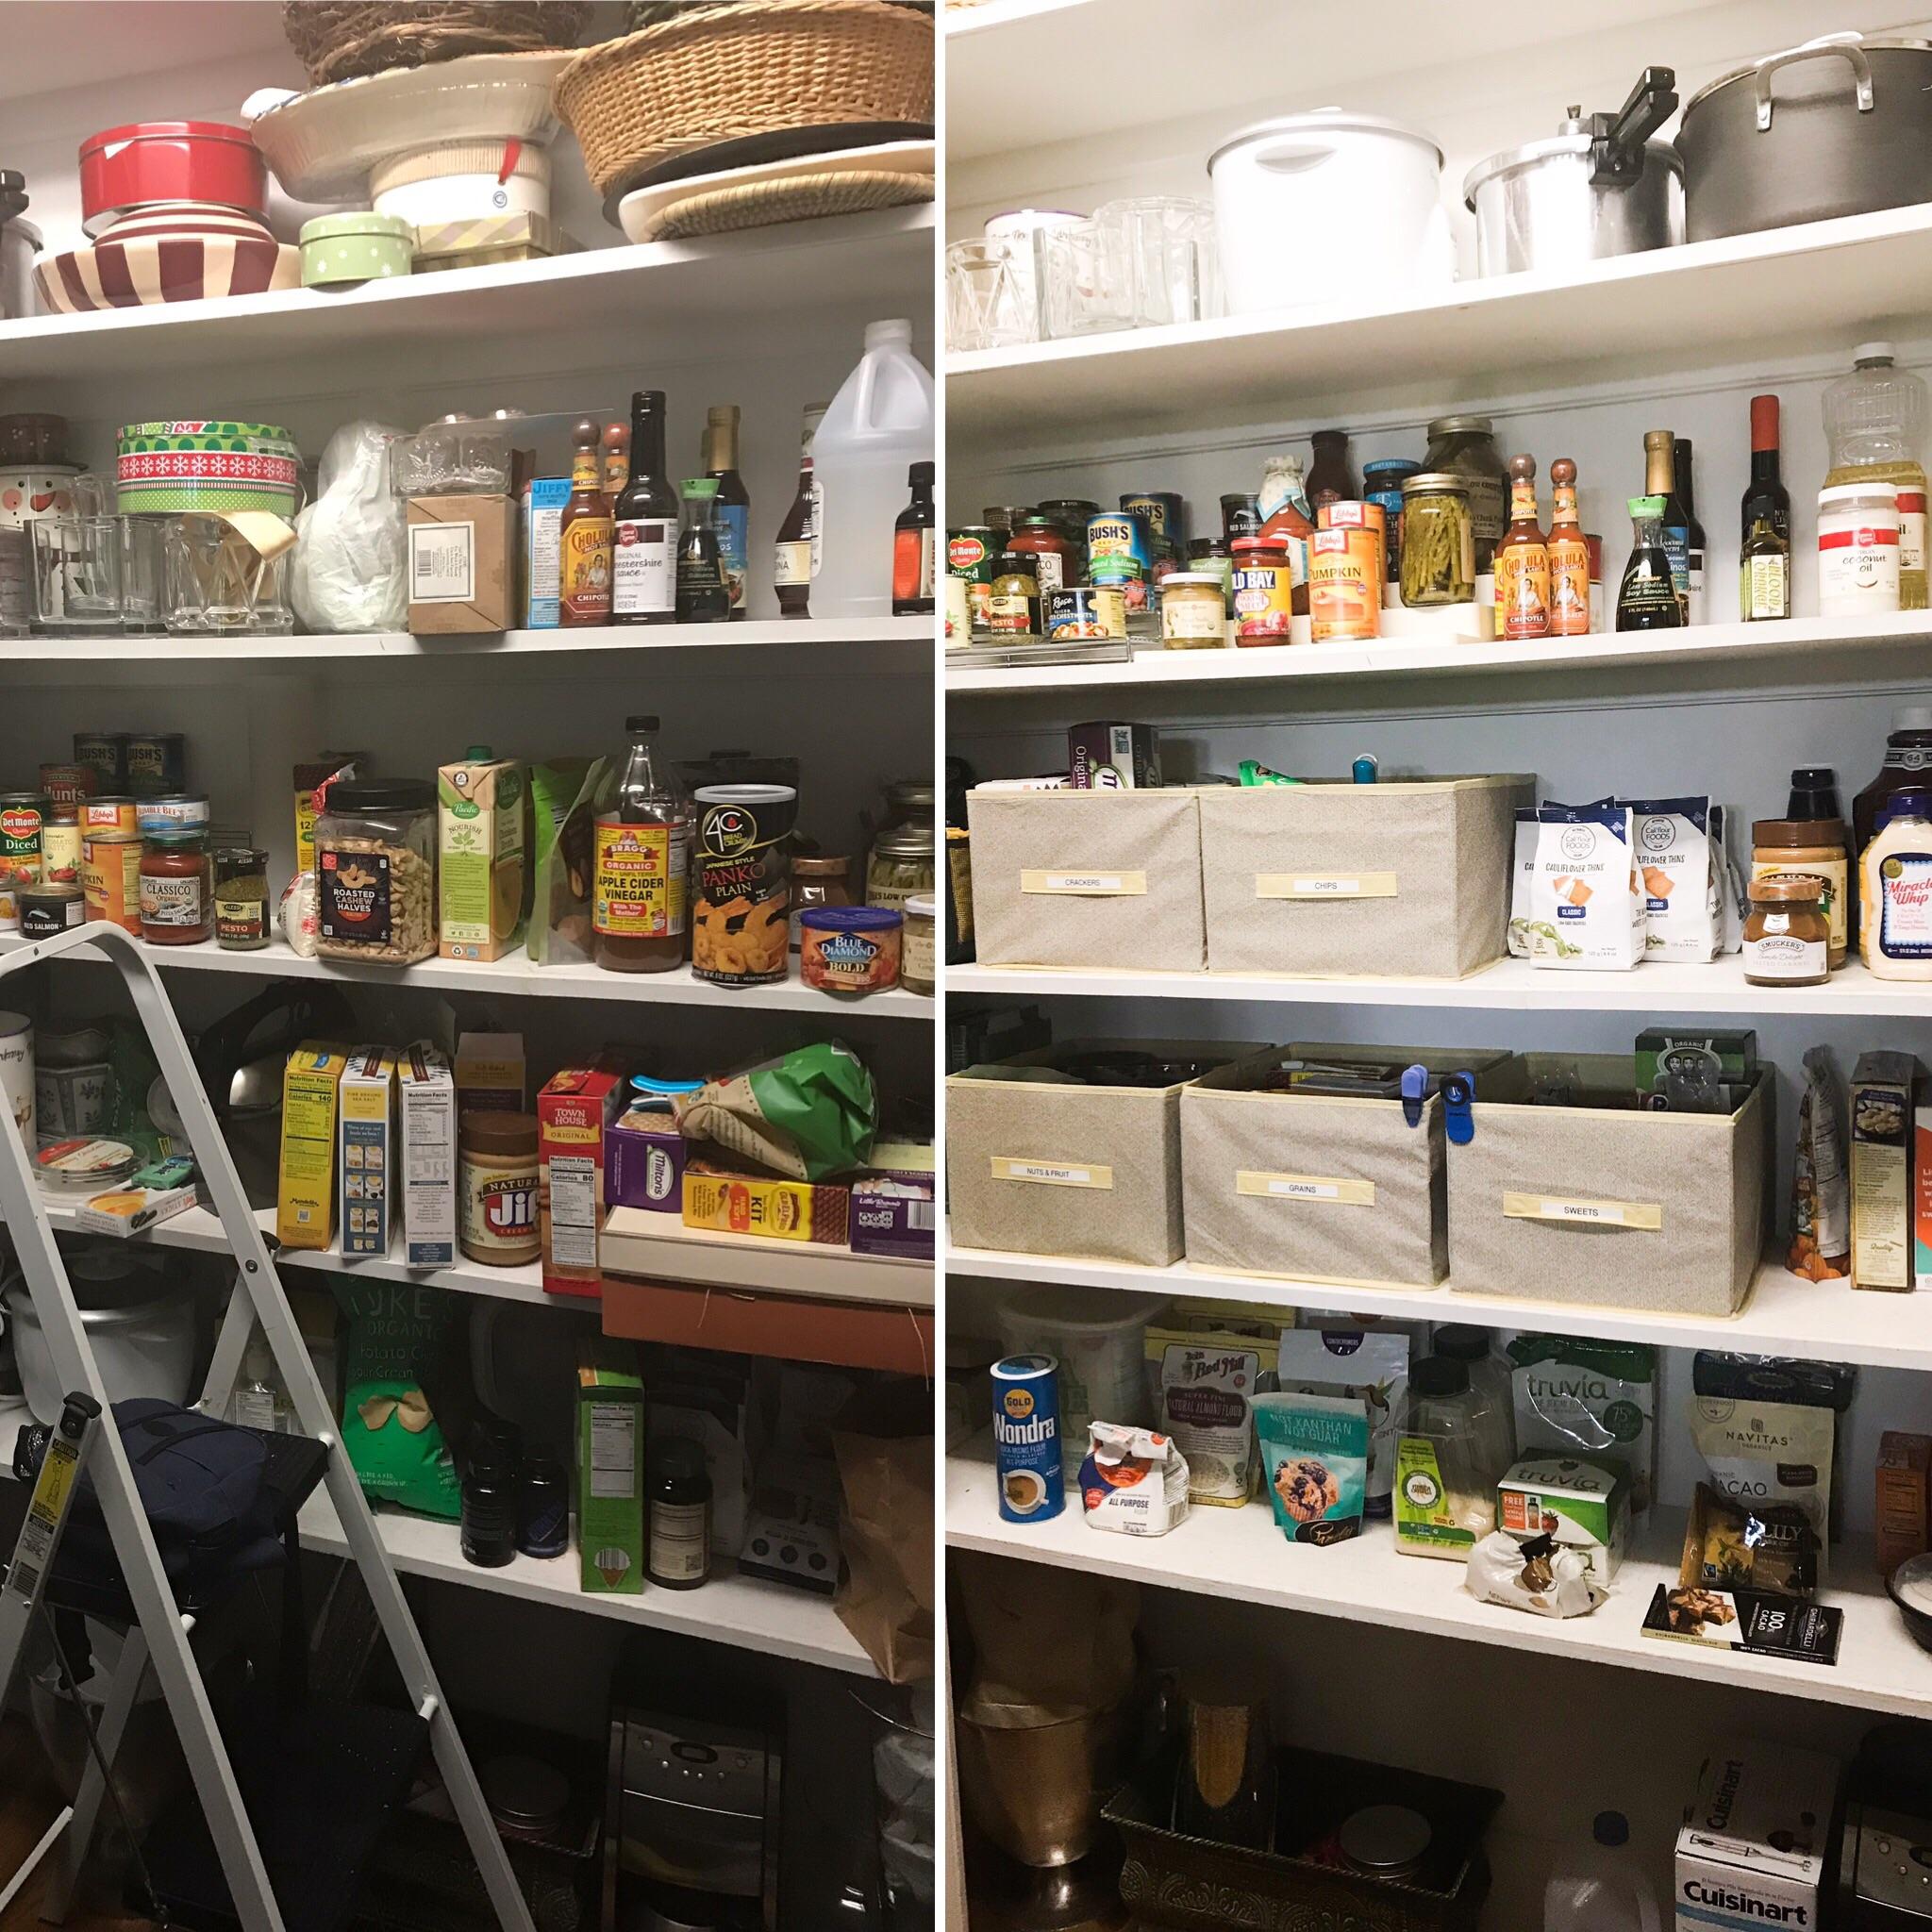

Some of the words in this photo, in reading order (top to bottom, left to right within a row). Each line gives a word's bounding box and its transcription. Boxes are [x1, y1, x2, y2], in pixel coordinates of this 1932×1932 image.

[1090, 525, 1129, 542] BUSH'S
[1842, 555, 1888, 564] coconut
[1309, 566, 1361, 579] PUMPKIN
[1670, 562, 1687, 571] inos
[1859, 564, 1873, 573] oil
[1232, 573, 1244, 590] LD
[2, 817, 14, 826] Del
[14, 817, 39, 826] Monte
[705, 811, 743, 853] 4C
[6, 839, 38, 849] Diced
[610, 844, 648, 853] BRAGG
[734, 857, 755, 866] STYLE
[1668, 855, 1686, 863] THINS
[606, 861, 652, 870] ORGANIC
[1545, 862, 1585, 873] CAULIFLOWER
[1587, 862, 1605, 873] THINS
[702, 862, 766, 887] PANKO
[598, 875, 626, 889] APPLE
[629, 877, 664, 889] CIDER
[1064, 878, 1101, 887] CRACKERS
[146, 884, 191, 895] CLASSICO
[333, 888, 375, 898] ROASTED
[605, 889, 654, 901] VINEGAR
[716, 882, 753, 897] PLAIN
[335, 895, 373, 906] CASHEW
[1892, 891, 1929, 906] Whip
[337, 903, 372, 912] HALVES
[835, 936, 863, 948] BLUE
[821, 943, 877, 957] DIAMOND
[829, 961, 866, 973] BOLD
[555, 1108, 585, 1119] TOWN
[555, 1117, 587, 1126] HOUSE
[1026, 1167, 1043, 1176] NUTS
[1050, 1170, 1070, 1178] FRUIT
[490, 1177, 539, 1191] NATURA
[1289, 1184, 1316, 1193] GRAINS
[750, 1196, 764, 1224] KIT
[1564, 1206, 1599, 1217] SWEETS
[1185, 1352, 1205, 1360] Bob's
[1193, 1358, 1220, 1381] Red
[1007, 1397, 1031, 1407] GOLD
[993, 1411, 1055, 1444] Wondra
[1270, 1414, 1291, 1426] NOT
[1295, 1416, 1352, 1435] XANTHAN
[1284, 1424, 1307, 1437] NOT
[1726, 1431, 1789, 1446] NAVITAS
[1718, 1481, 1767, 1496] ACAO
[1108, 1498, 1120, 1507] ALL
[1120, 1498, 1150, 1508] PURPOSE
[1504, 1495, 1524, 1507] FREE
[1757, 1609, 1770, 1631] CACAO
[1804, 1607, 1819, 1648] GHIRARDELLI
[1706, 1758, 1743, 1830] Cuisinart
[1684, 1881, 1807, 1925] Cuisinart
